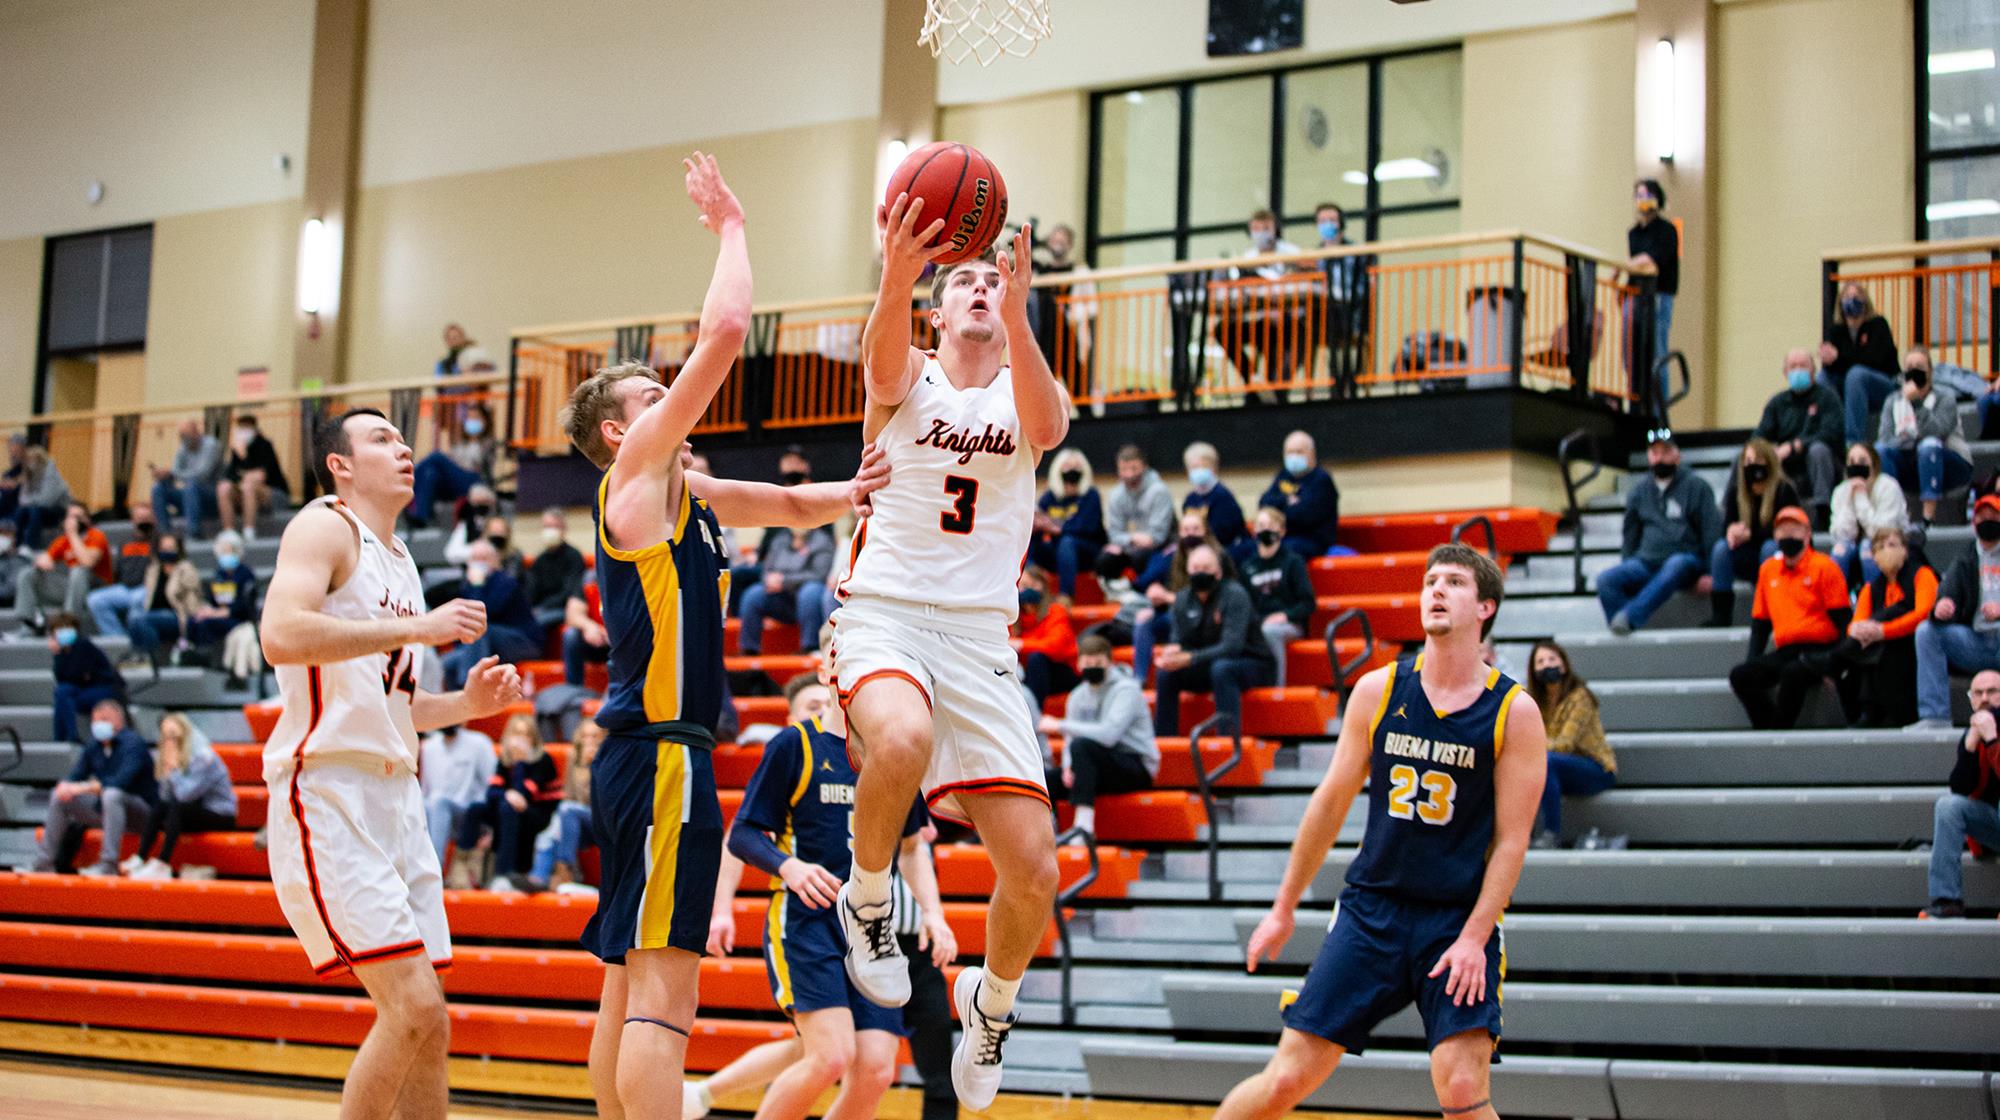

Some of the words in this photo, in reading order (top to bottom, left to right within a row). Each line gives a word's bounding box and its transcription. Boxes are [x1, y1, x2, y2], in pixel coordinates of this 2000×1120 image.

[950, 177, 990, 253] Wilson
[915, 418, 1016, 466] Knights
[939, 474, 980, 535] 3
[1384, 732, 1430, 760] BUENA
[1432, 741, 1475, 769] VISTA
[820, 783, 856, 805] BUEN
[1388, 764, 1457, 826] 23
